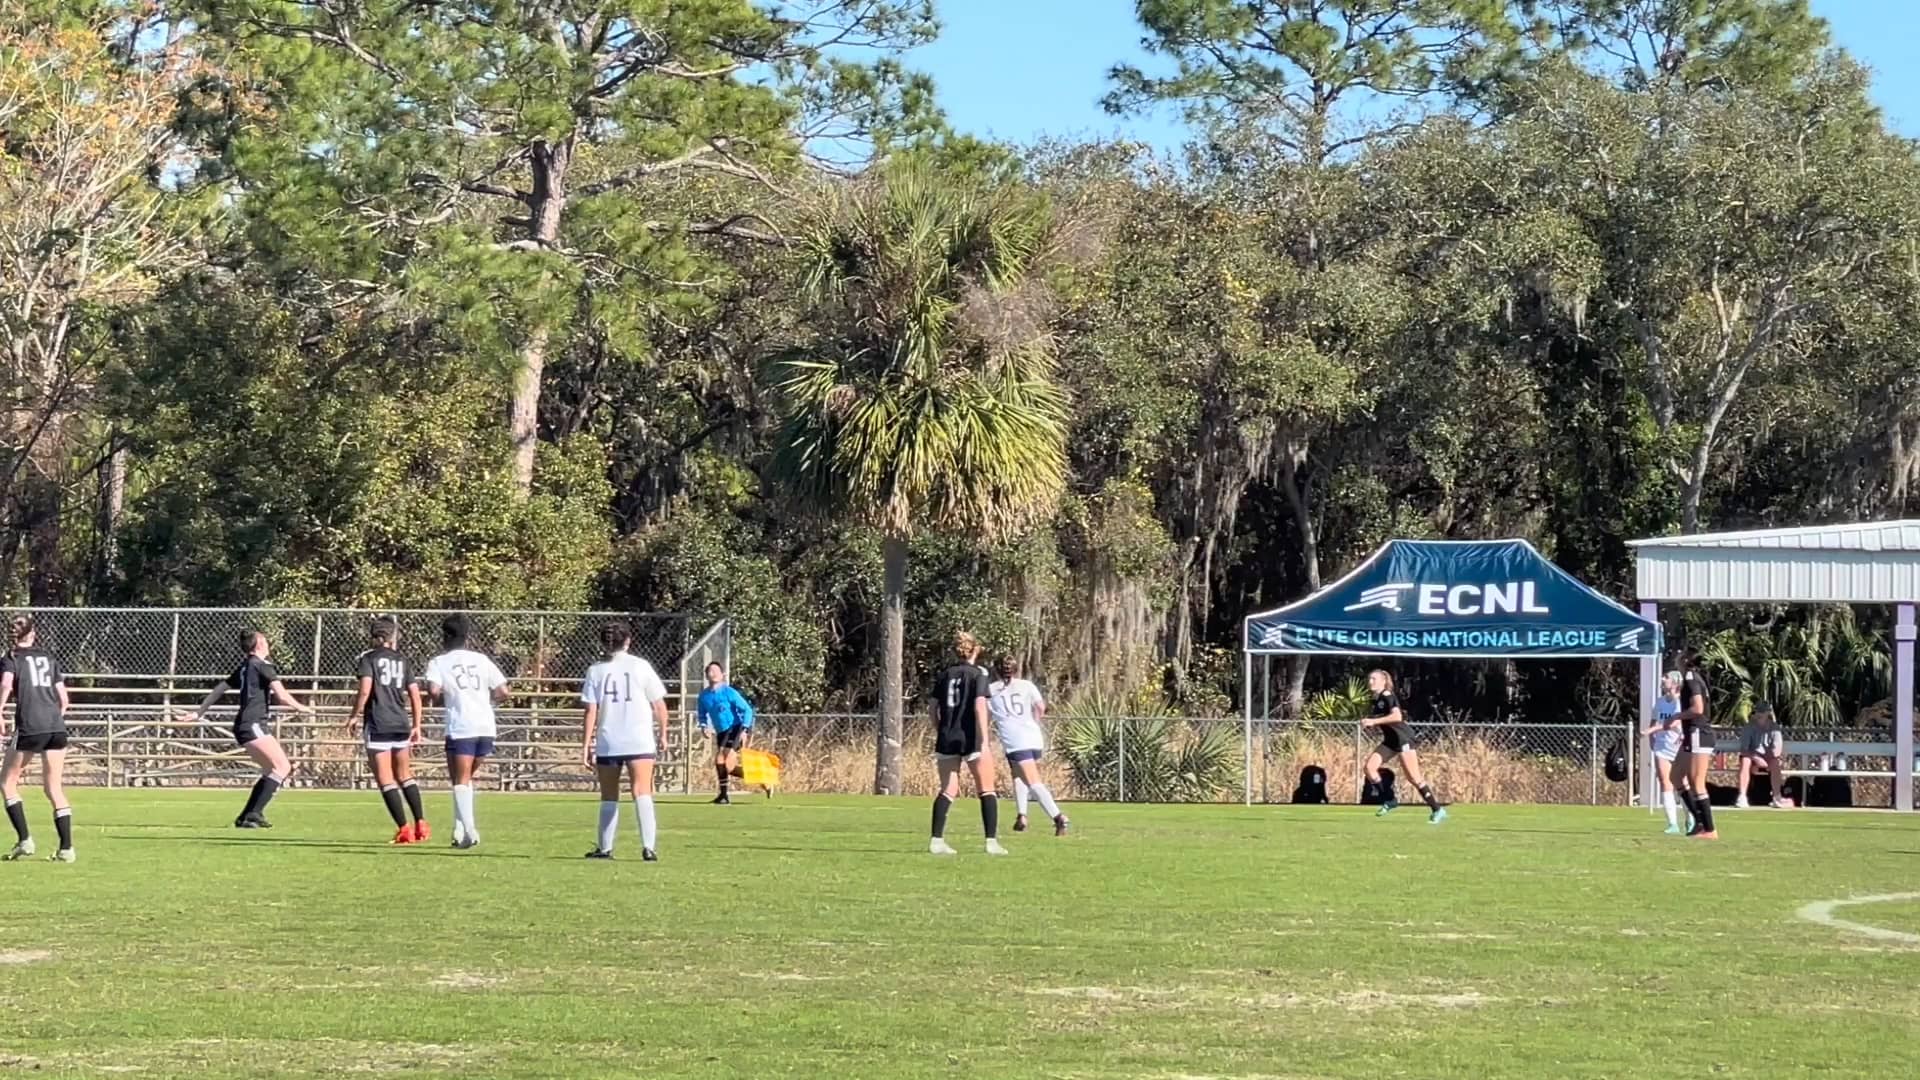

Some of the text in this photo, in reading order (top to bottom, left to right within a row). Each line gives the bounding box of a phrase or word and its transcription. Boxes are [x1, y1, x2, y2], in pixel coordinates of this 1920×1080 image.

[1418, 581, 1549, 615] ECNL
[1296, 627, 1606, 647] ELITE CLUBS NATIONAL LEAGUE
[26, 656, 51, 688] 12
[377, 657, 404, 689] 34
[452, 664, 481, 691] 25
[604, 672, 632, 703] 41
[1001, 692, 1024, 717] 16
